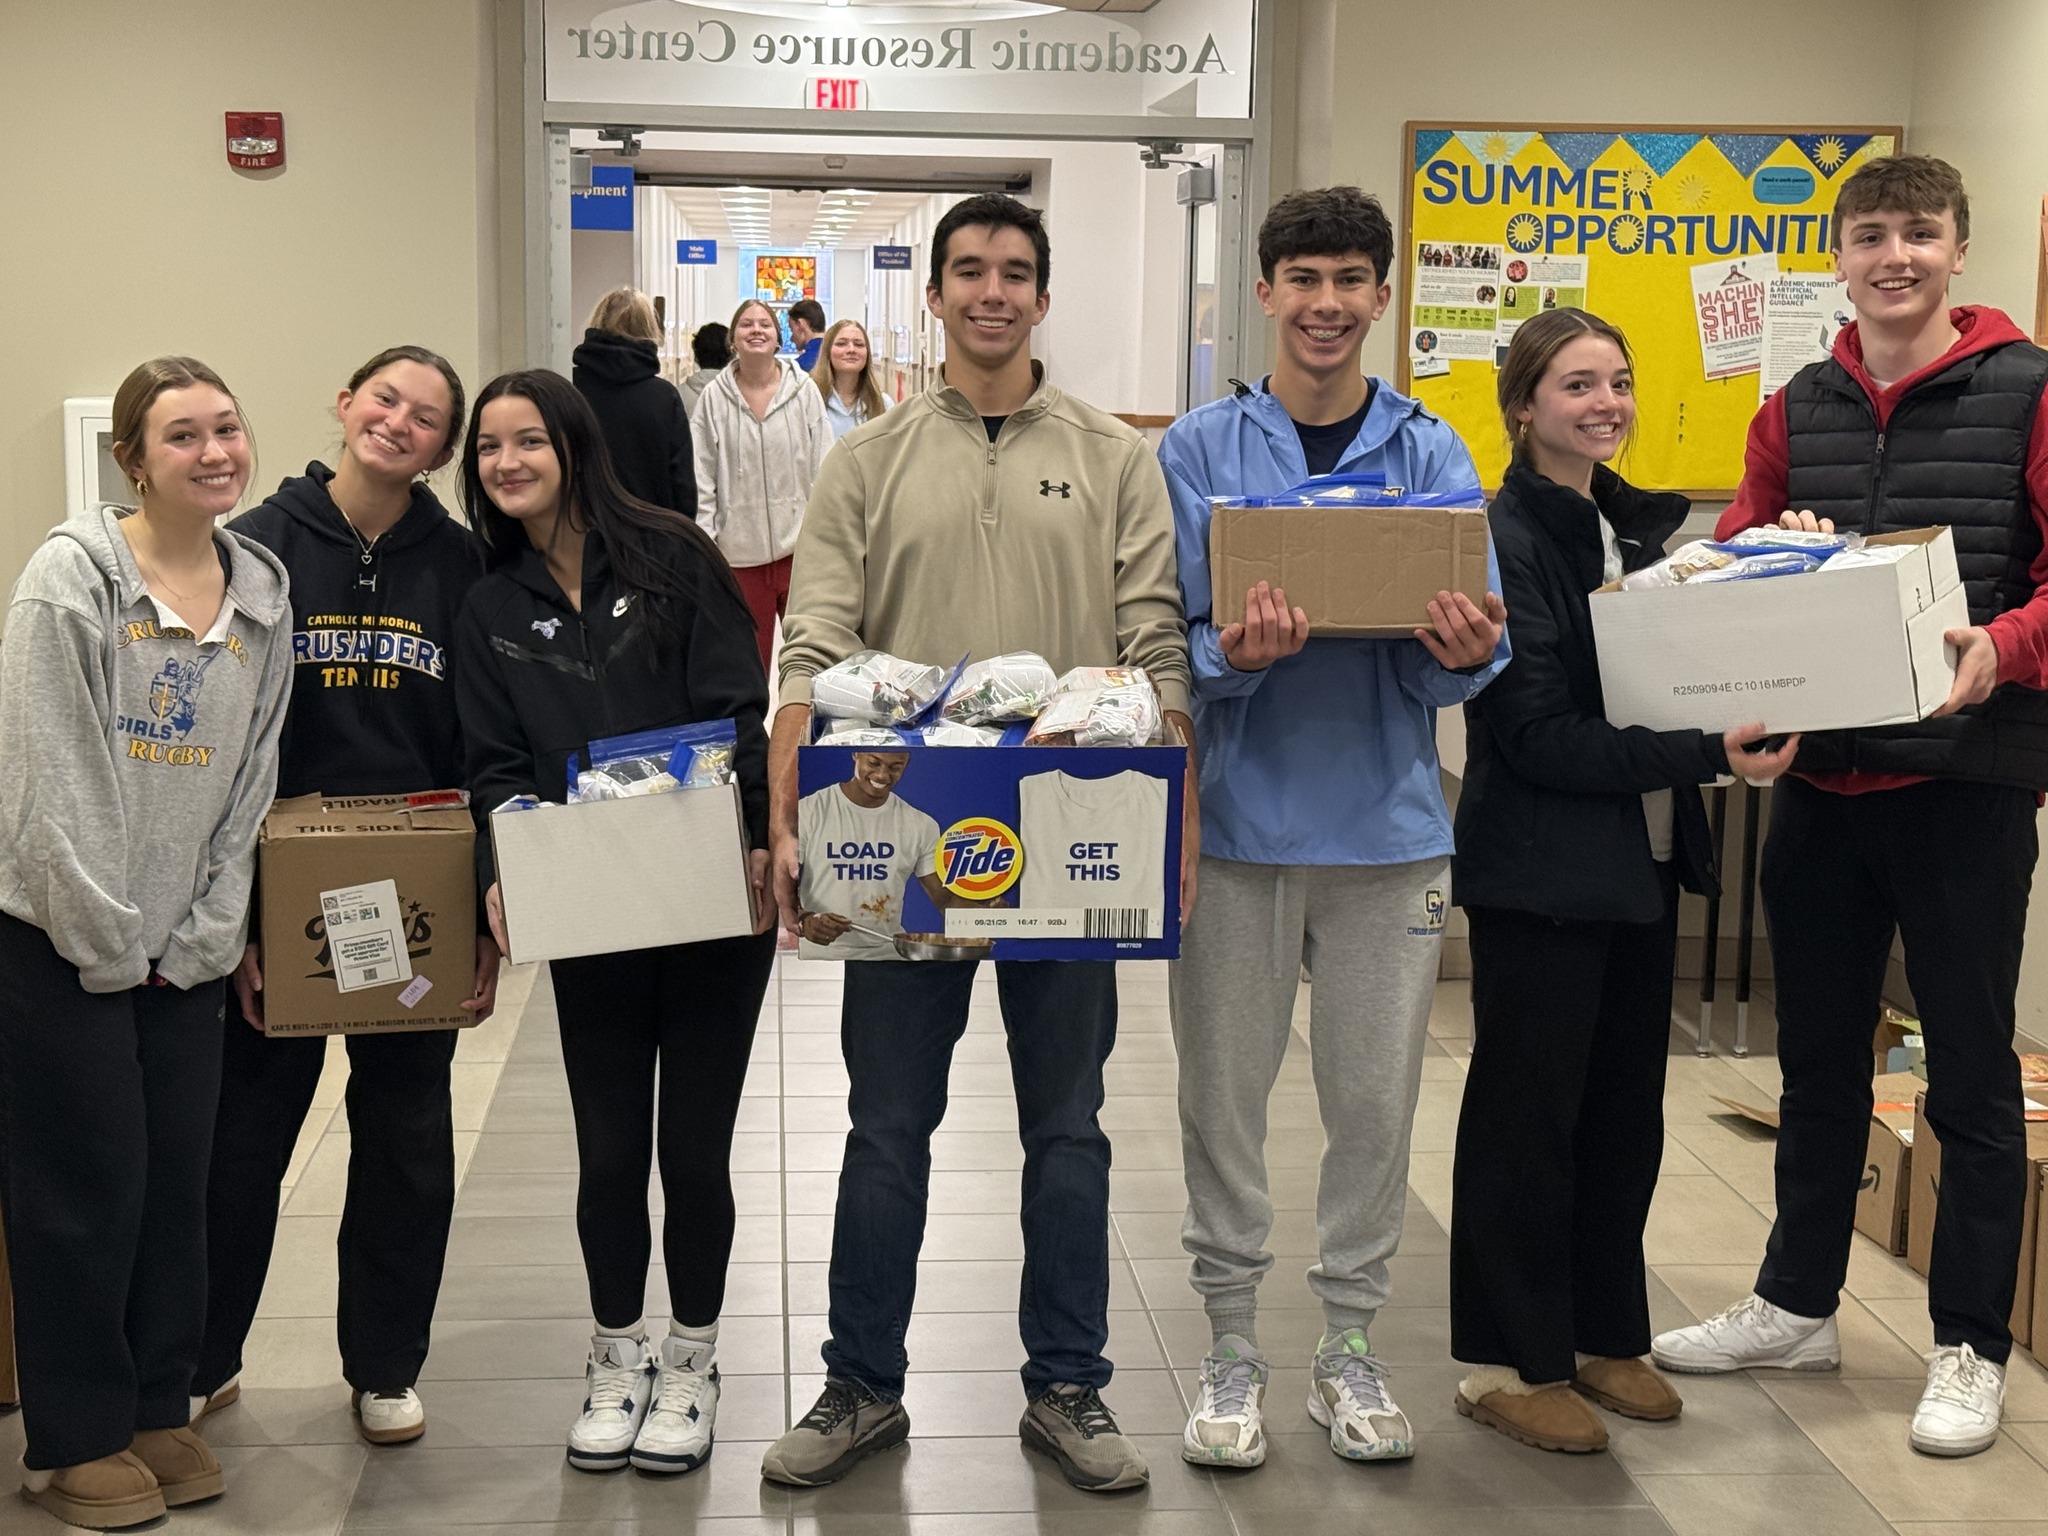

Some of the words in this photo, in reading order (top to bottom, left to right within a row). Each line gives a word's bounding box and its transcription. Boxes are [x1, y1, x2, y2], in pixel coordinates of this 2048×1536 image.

[816, 78, 859, 110] EXIT
[240, 157, 267, 167] FIRE
[571, 184, 627, 199] pment
[1506, 212, 1834, 256] OPPORTUNITI
[1770, 280, 1805, 288] ACADEMIC
[1698, 281, 1765, 307] MACHIN
[1769, 293, 1818, 301] INTELLIGENCE
[1701, 297, 1764, 331] SHE
[1704, 330, 1719, 344] IS
[1723, 321, 1764, 340] HIRIN
[307, 615, 358, 627] CATHOLIC
[293, 629, 447, 682] RUSADERS
[117, 715, 173, 741] GIRLS
[127, 738, 217, 767] RUGBY
[295, 825, 346, 834] THIS
[356, 824, 405, 833] SIDE
[826, 842, 895, 859] LOAD
[1069, 842, 1119, 860] GET
[943, 837, 1016, 886] Tide
[832, 863, 889, 881] THIS
[1065, 864, 1121, 881] THIS
